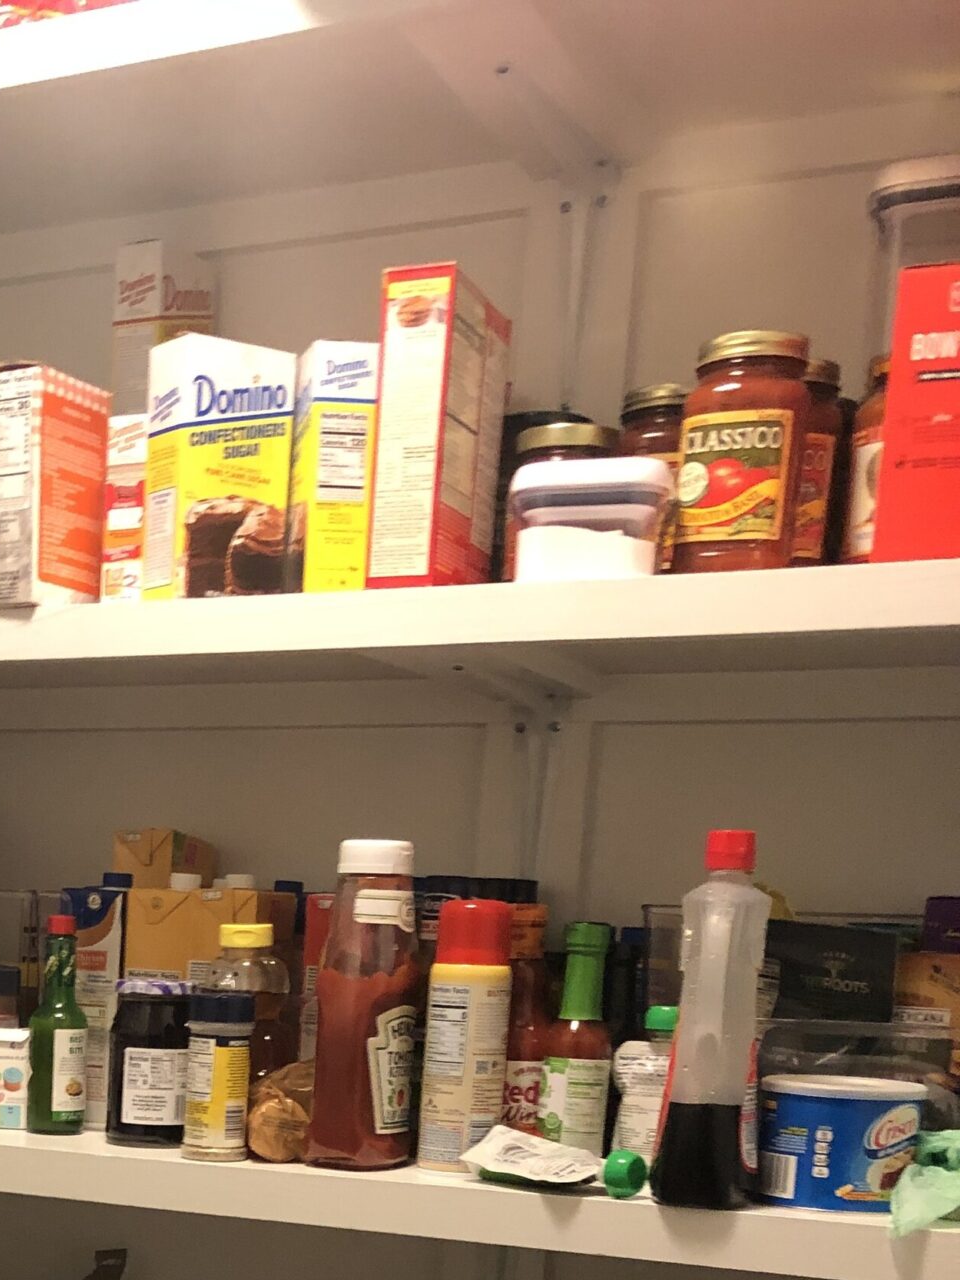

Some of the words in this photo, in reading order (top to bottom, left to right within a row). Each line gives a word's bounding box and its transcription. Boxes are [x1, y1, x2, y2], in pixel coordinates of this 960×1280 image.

[327, 358, 369, 375] Domino
[193, 374, 288, 418] Domino
[190, 422, 287, 446] CONFECTIONERS
[685, 426, 783, 455] CLASSICO
[223, 443, 261, 460] SUGAR
[129, 971, 159, 979] Nutrition
[161, 972, 179, 980] Facts
